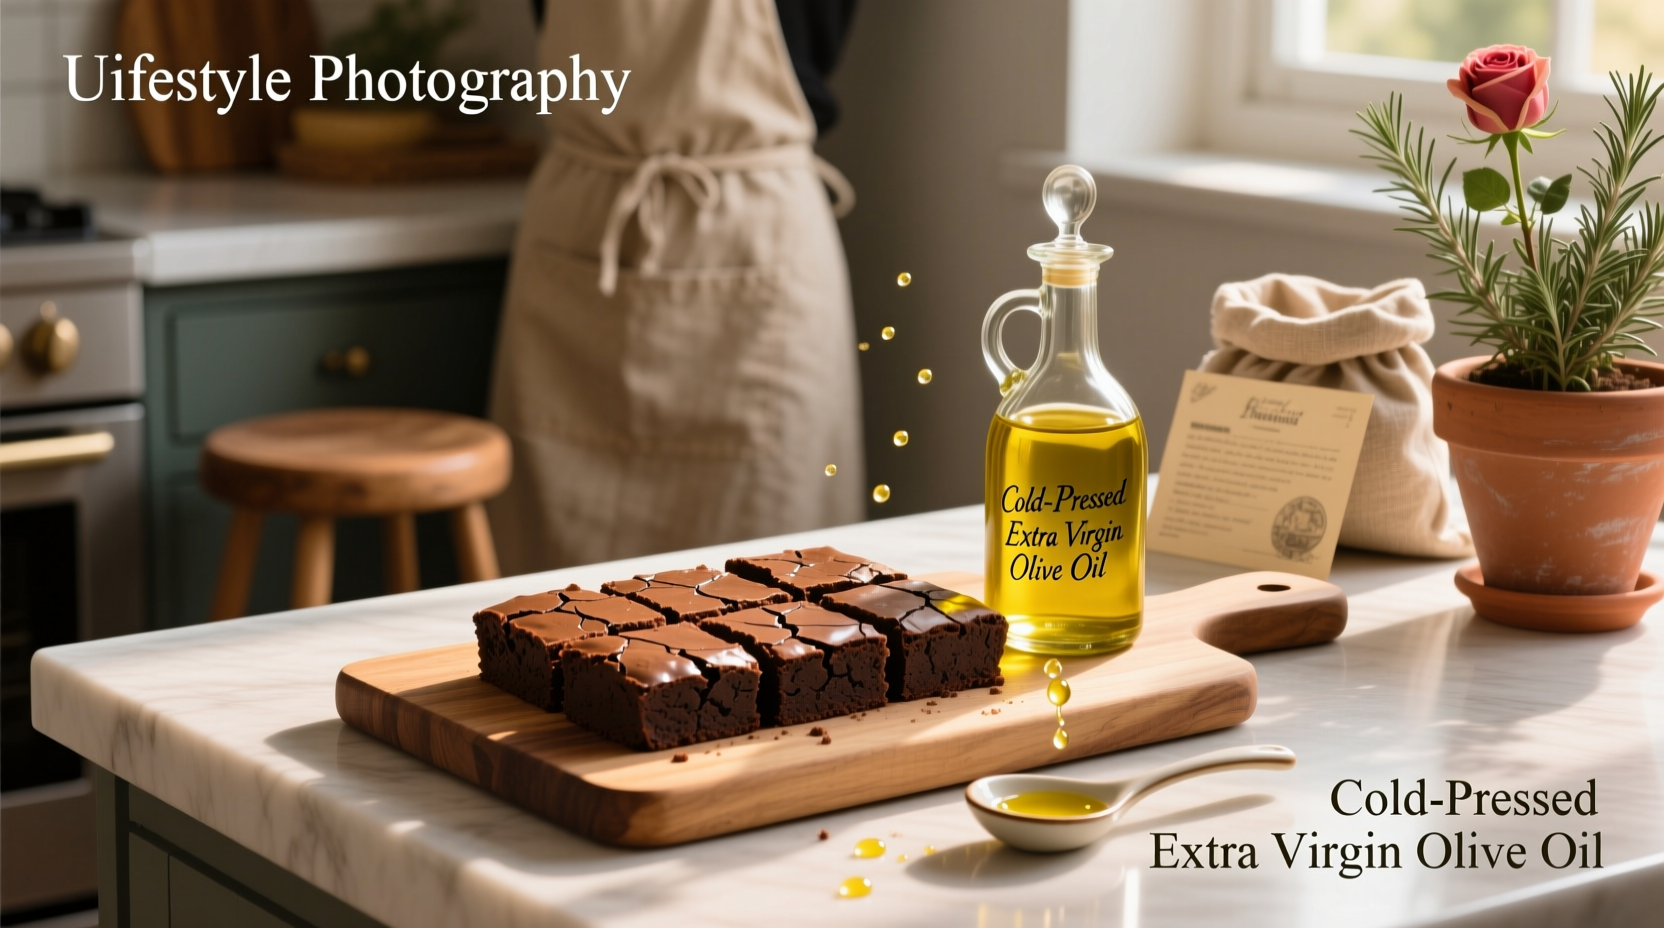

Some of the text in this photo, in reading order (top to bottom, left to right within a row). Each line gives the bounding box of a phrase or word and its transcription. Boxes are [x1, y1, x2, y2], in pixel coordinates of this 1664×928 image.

[1001, 478, 1128, 513] Cold-Pressed
[1005, 520, 1124, 552] Extra Virgin
[1010, 551, 1108, 581] Olive Oil
